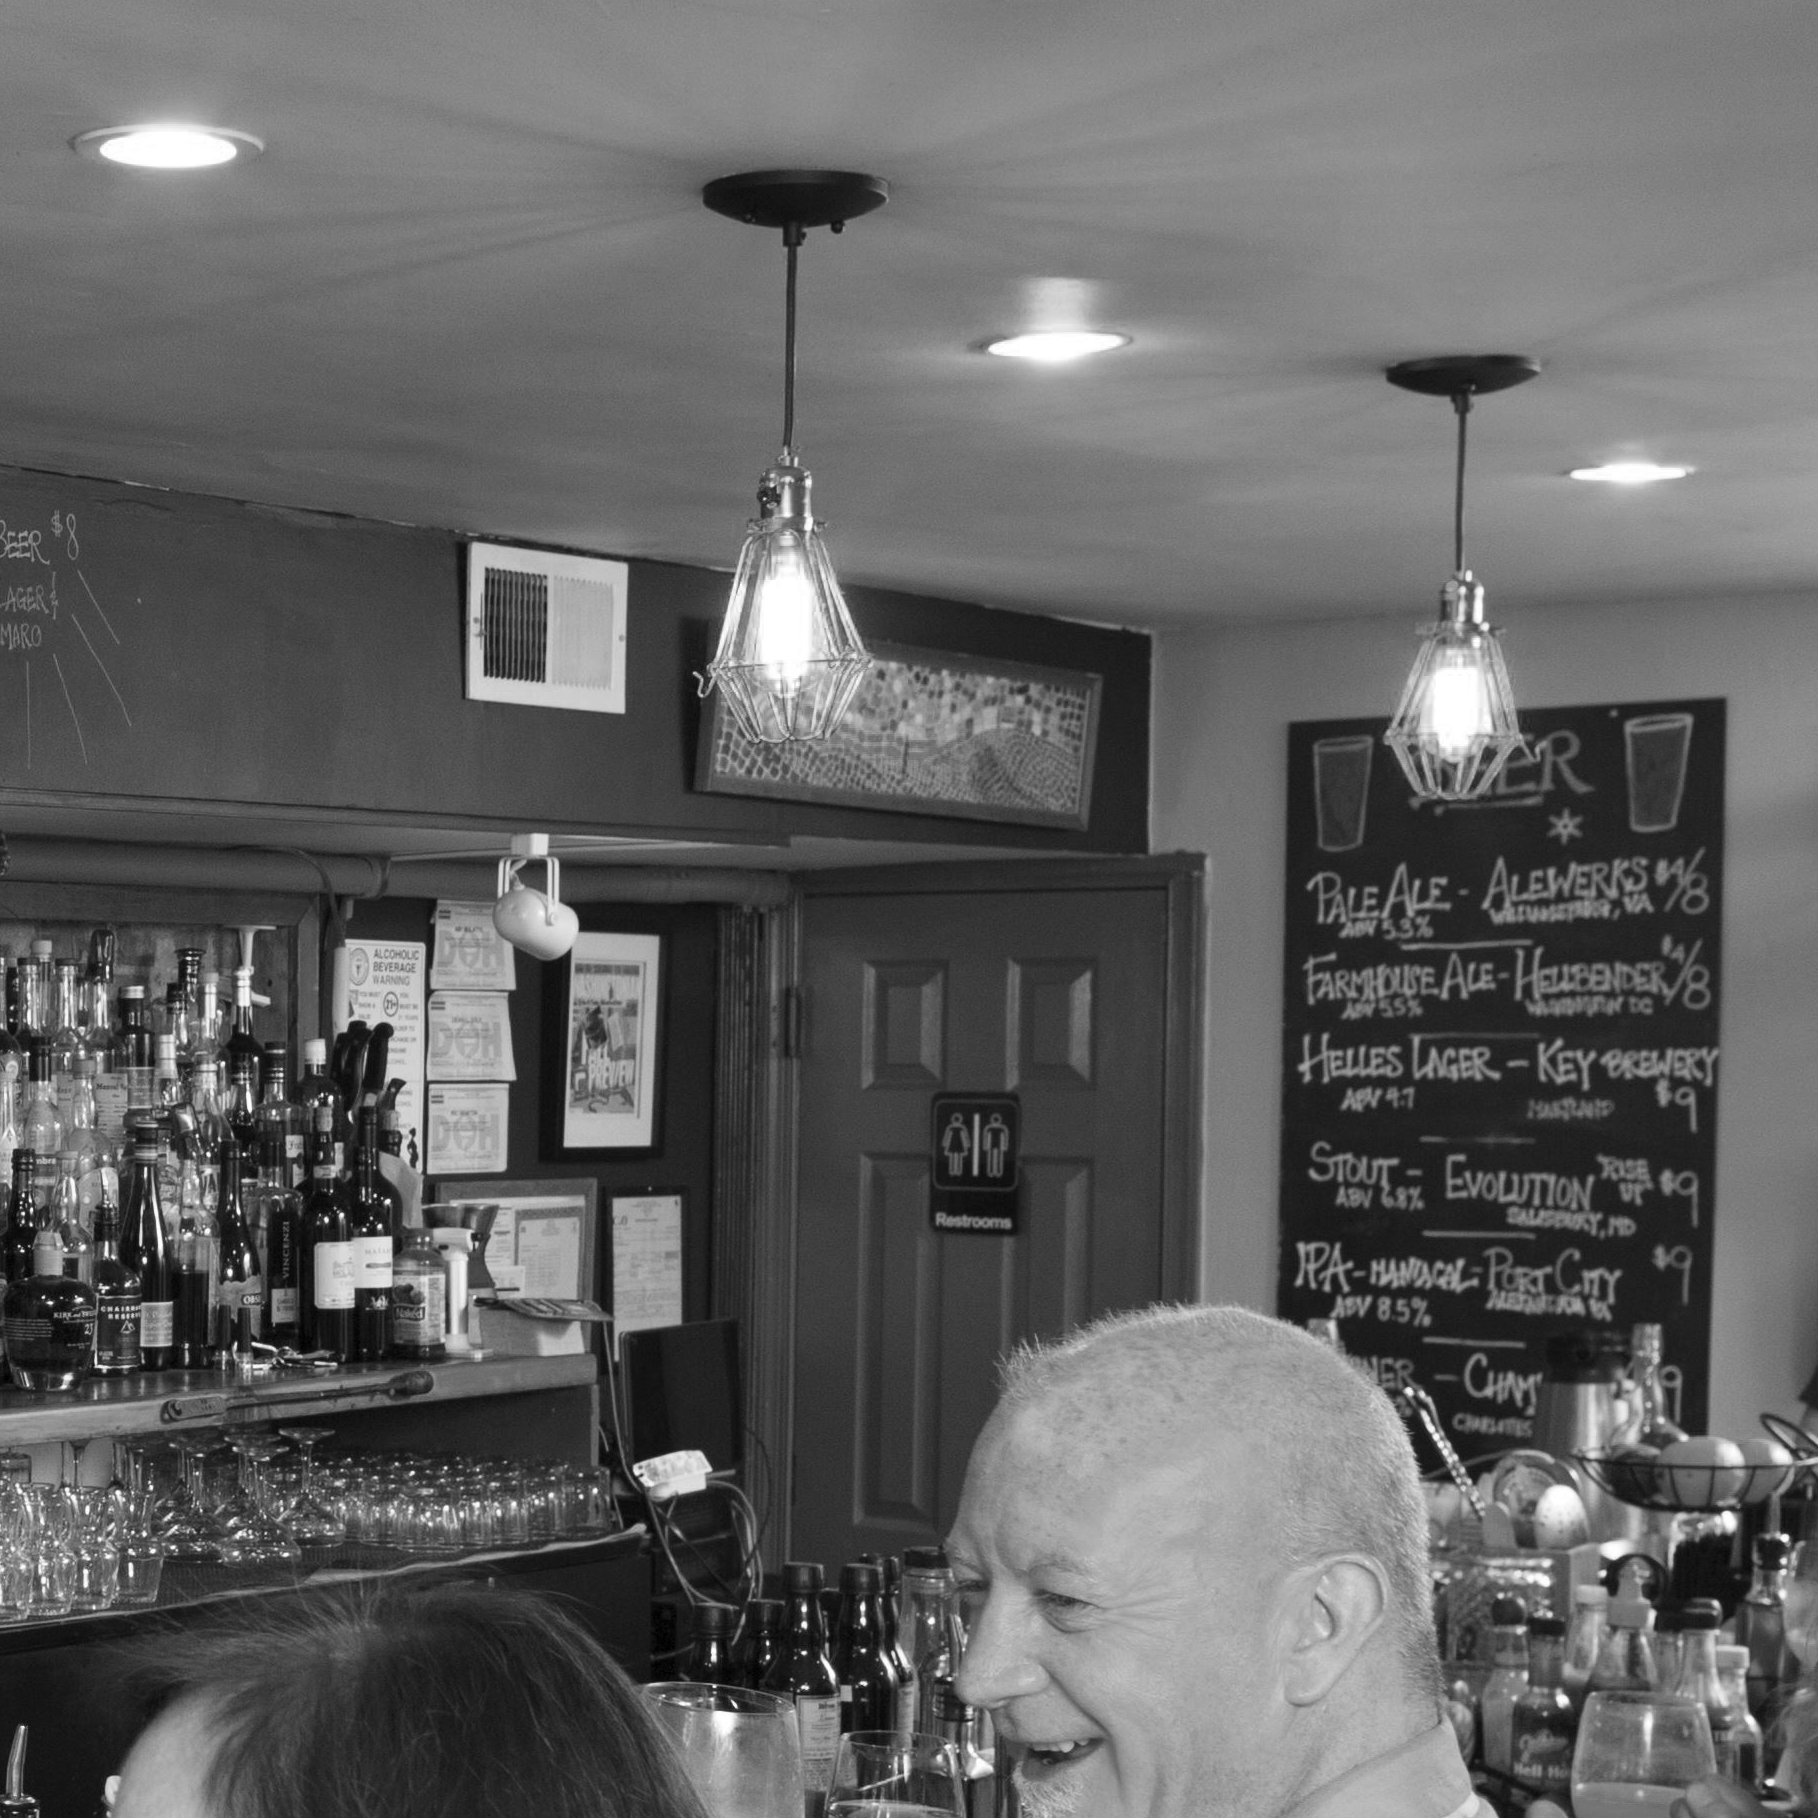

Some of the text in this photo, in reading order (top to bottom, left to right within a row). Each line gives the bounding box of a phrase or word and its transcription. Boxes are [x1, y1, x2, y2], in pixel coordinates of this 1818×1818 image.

[1306, 855, 1648, 924] PALE ALE ALEWERKS
[372, 947, 420, 960] ALCOHOLIC
[372, 961, 417, 973] BEVERAGE
[372, 974, 411, 986] WARNING
[1302, 946, 1667, 1006] FARMHOUSE ALE HELLBENDER
[1297, 1032, 1721, 1092] HELLES LAGER KEY BREWERY
[1307, 1141, 1700, 1229] STOUT EVOLUTION $9
[934, 1210, 1013, 1231] Restrooms
[1607, 1214, 1637, 1238] MD
[282, 1220, 291, 1280] VINCENZI
[1293, 1241, 1694, 1306] IPA MANIACAL PORT CITY $9
[395, 1306, 424, 1320] Naked
[1329, 1296, 1374, 1320] ABV
[1376, 1297, 1433, 1329] 8.5%
